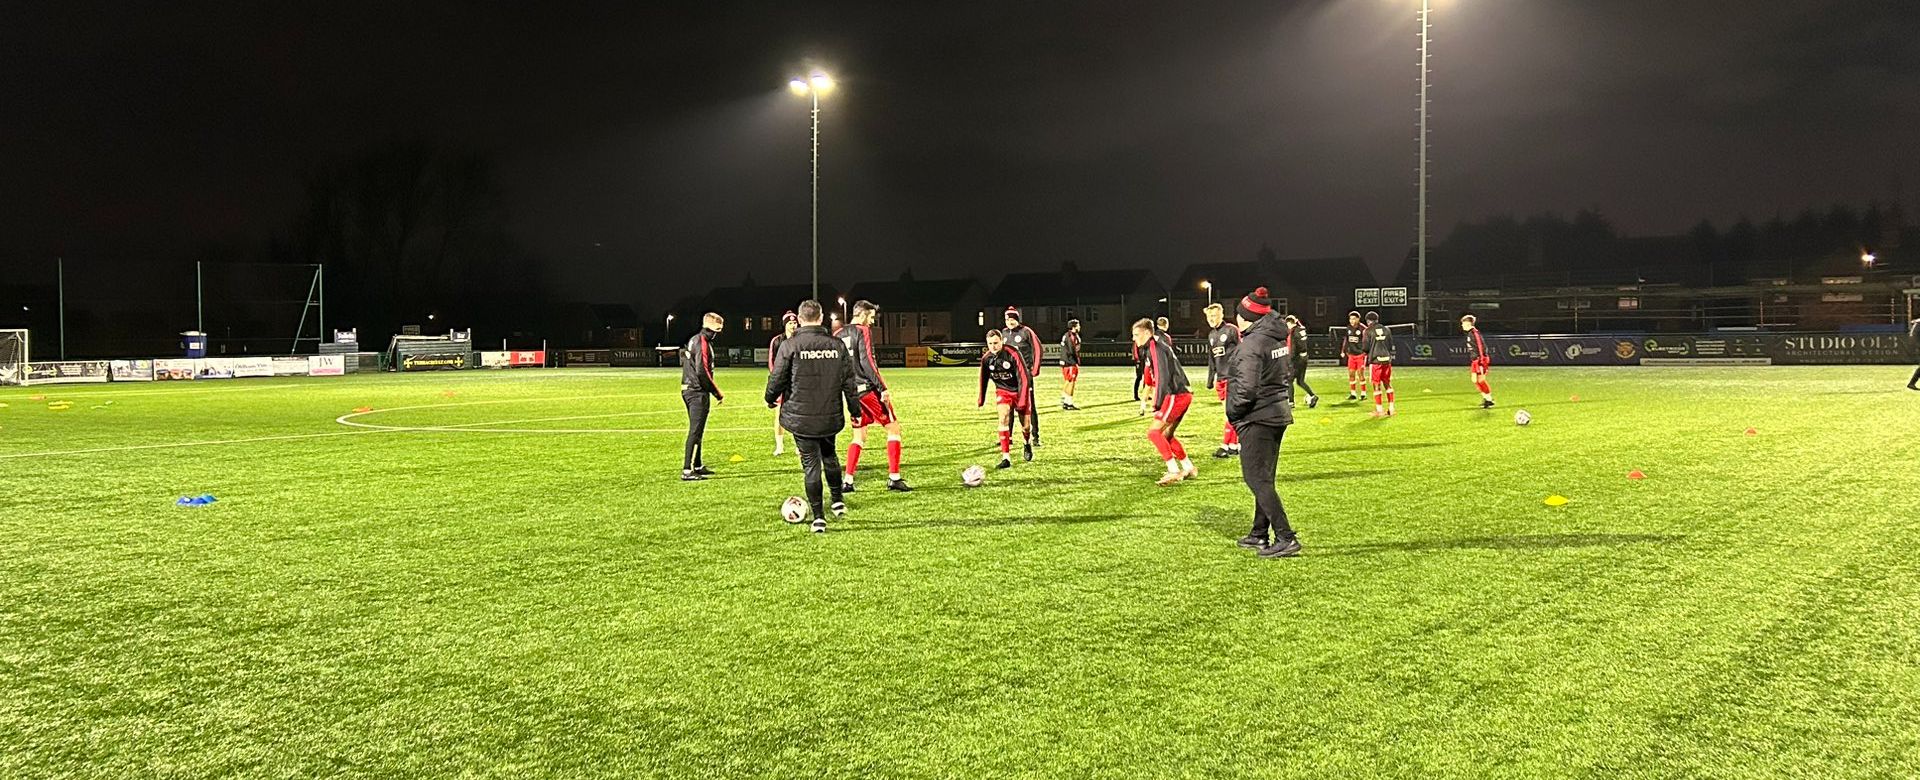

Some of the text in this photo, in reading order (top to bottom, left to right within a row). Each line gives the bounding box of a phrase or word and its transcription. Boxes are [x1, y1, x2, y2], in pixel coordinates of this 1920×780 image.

[1384, 296, 1399, 304] EXIT
[1784, 336, 1856, 349] STUDIO
[1175, 343, 1209, 354] STUDI
[1271, 346, 1290, 360] mac
[800, 349, 839, 360] macron
